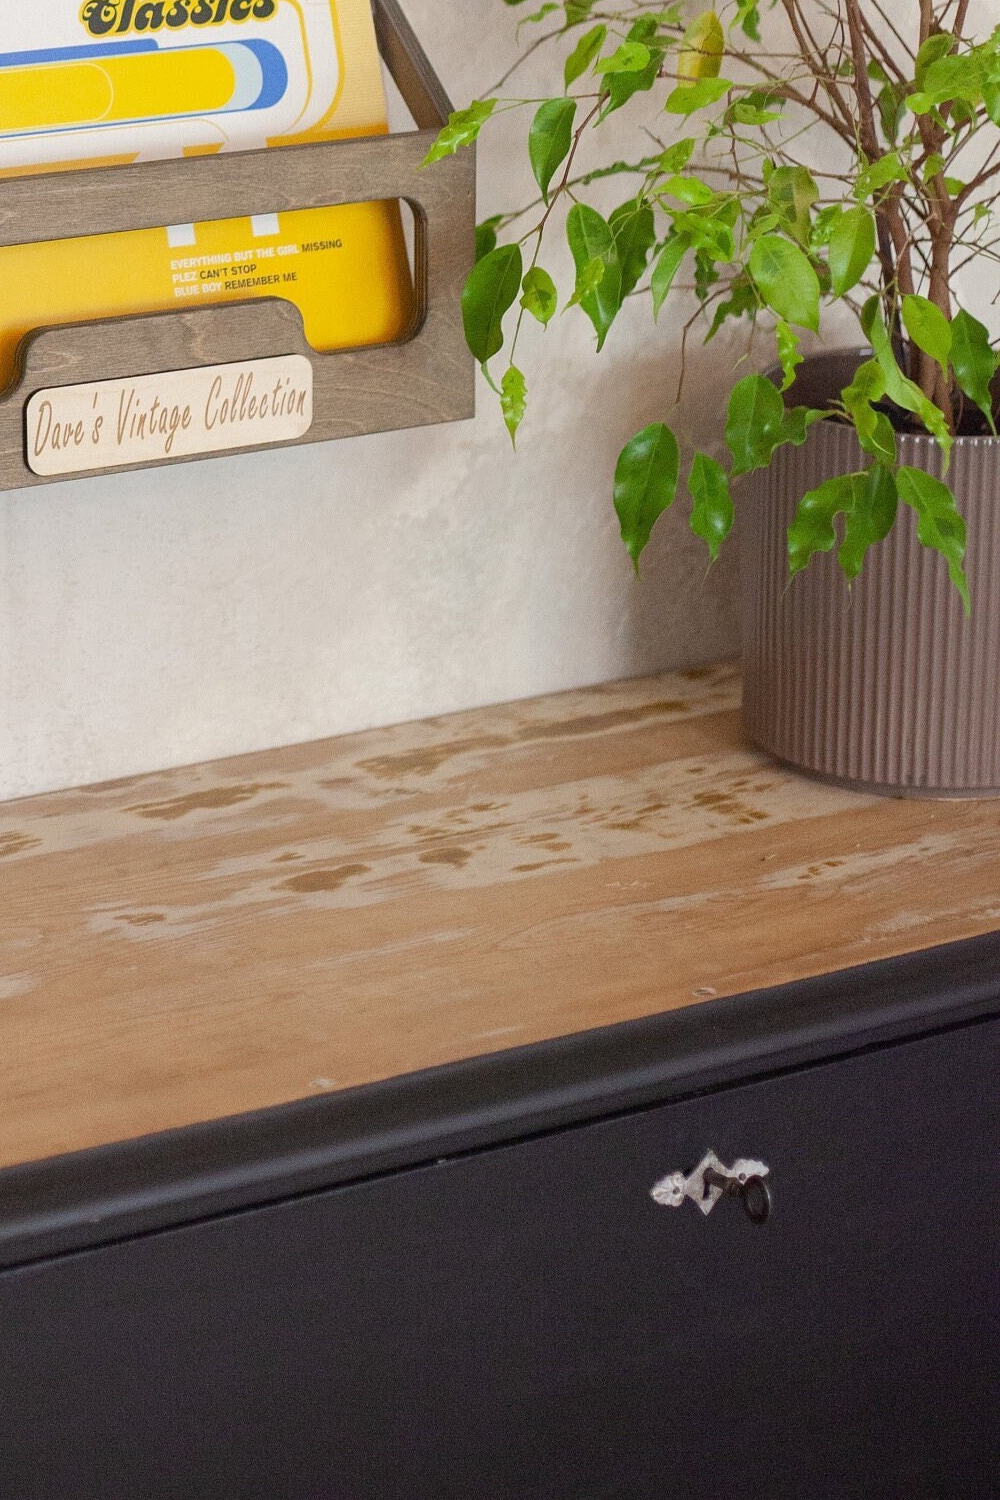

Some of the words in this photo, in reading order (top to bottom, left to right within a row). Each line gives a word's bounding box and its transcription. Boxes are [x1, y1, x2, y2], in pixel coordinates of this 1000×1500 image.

[170, 253, 232, 270] EVERYTHING
[234, 249, 254, 262] BUT
[256, 247, 276, 259] THE
[278, 244, 300, 256] GIRL
[301, 239, 342, 253] MISSING
[172, 270, 197, 284] PLEZ
[199, 266, 228, 280] CAN'T
[231, 263, 257, 276] STOP
[174, 284, 200, 297] BLUE
[201, 281, 222, 294] BOY
[224, 274, 280, 290] REMEMBER
[283, 271, 297, 283] ME
[34, 391, 104, 457] Dave's
[116, 388, 192, 454] Vintage
[204, 371, 308, 432] Collection
